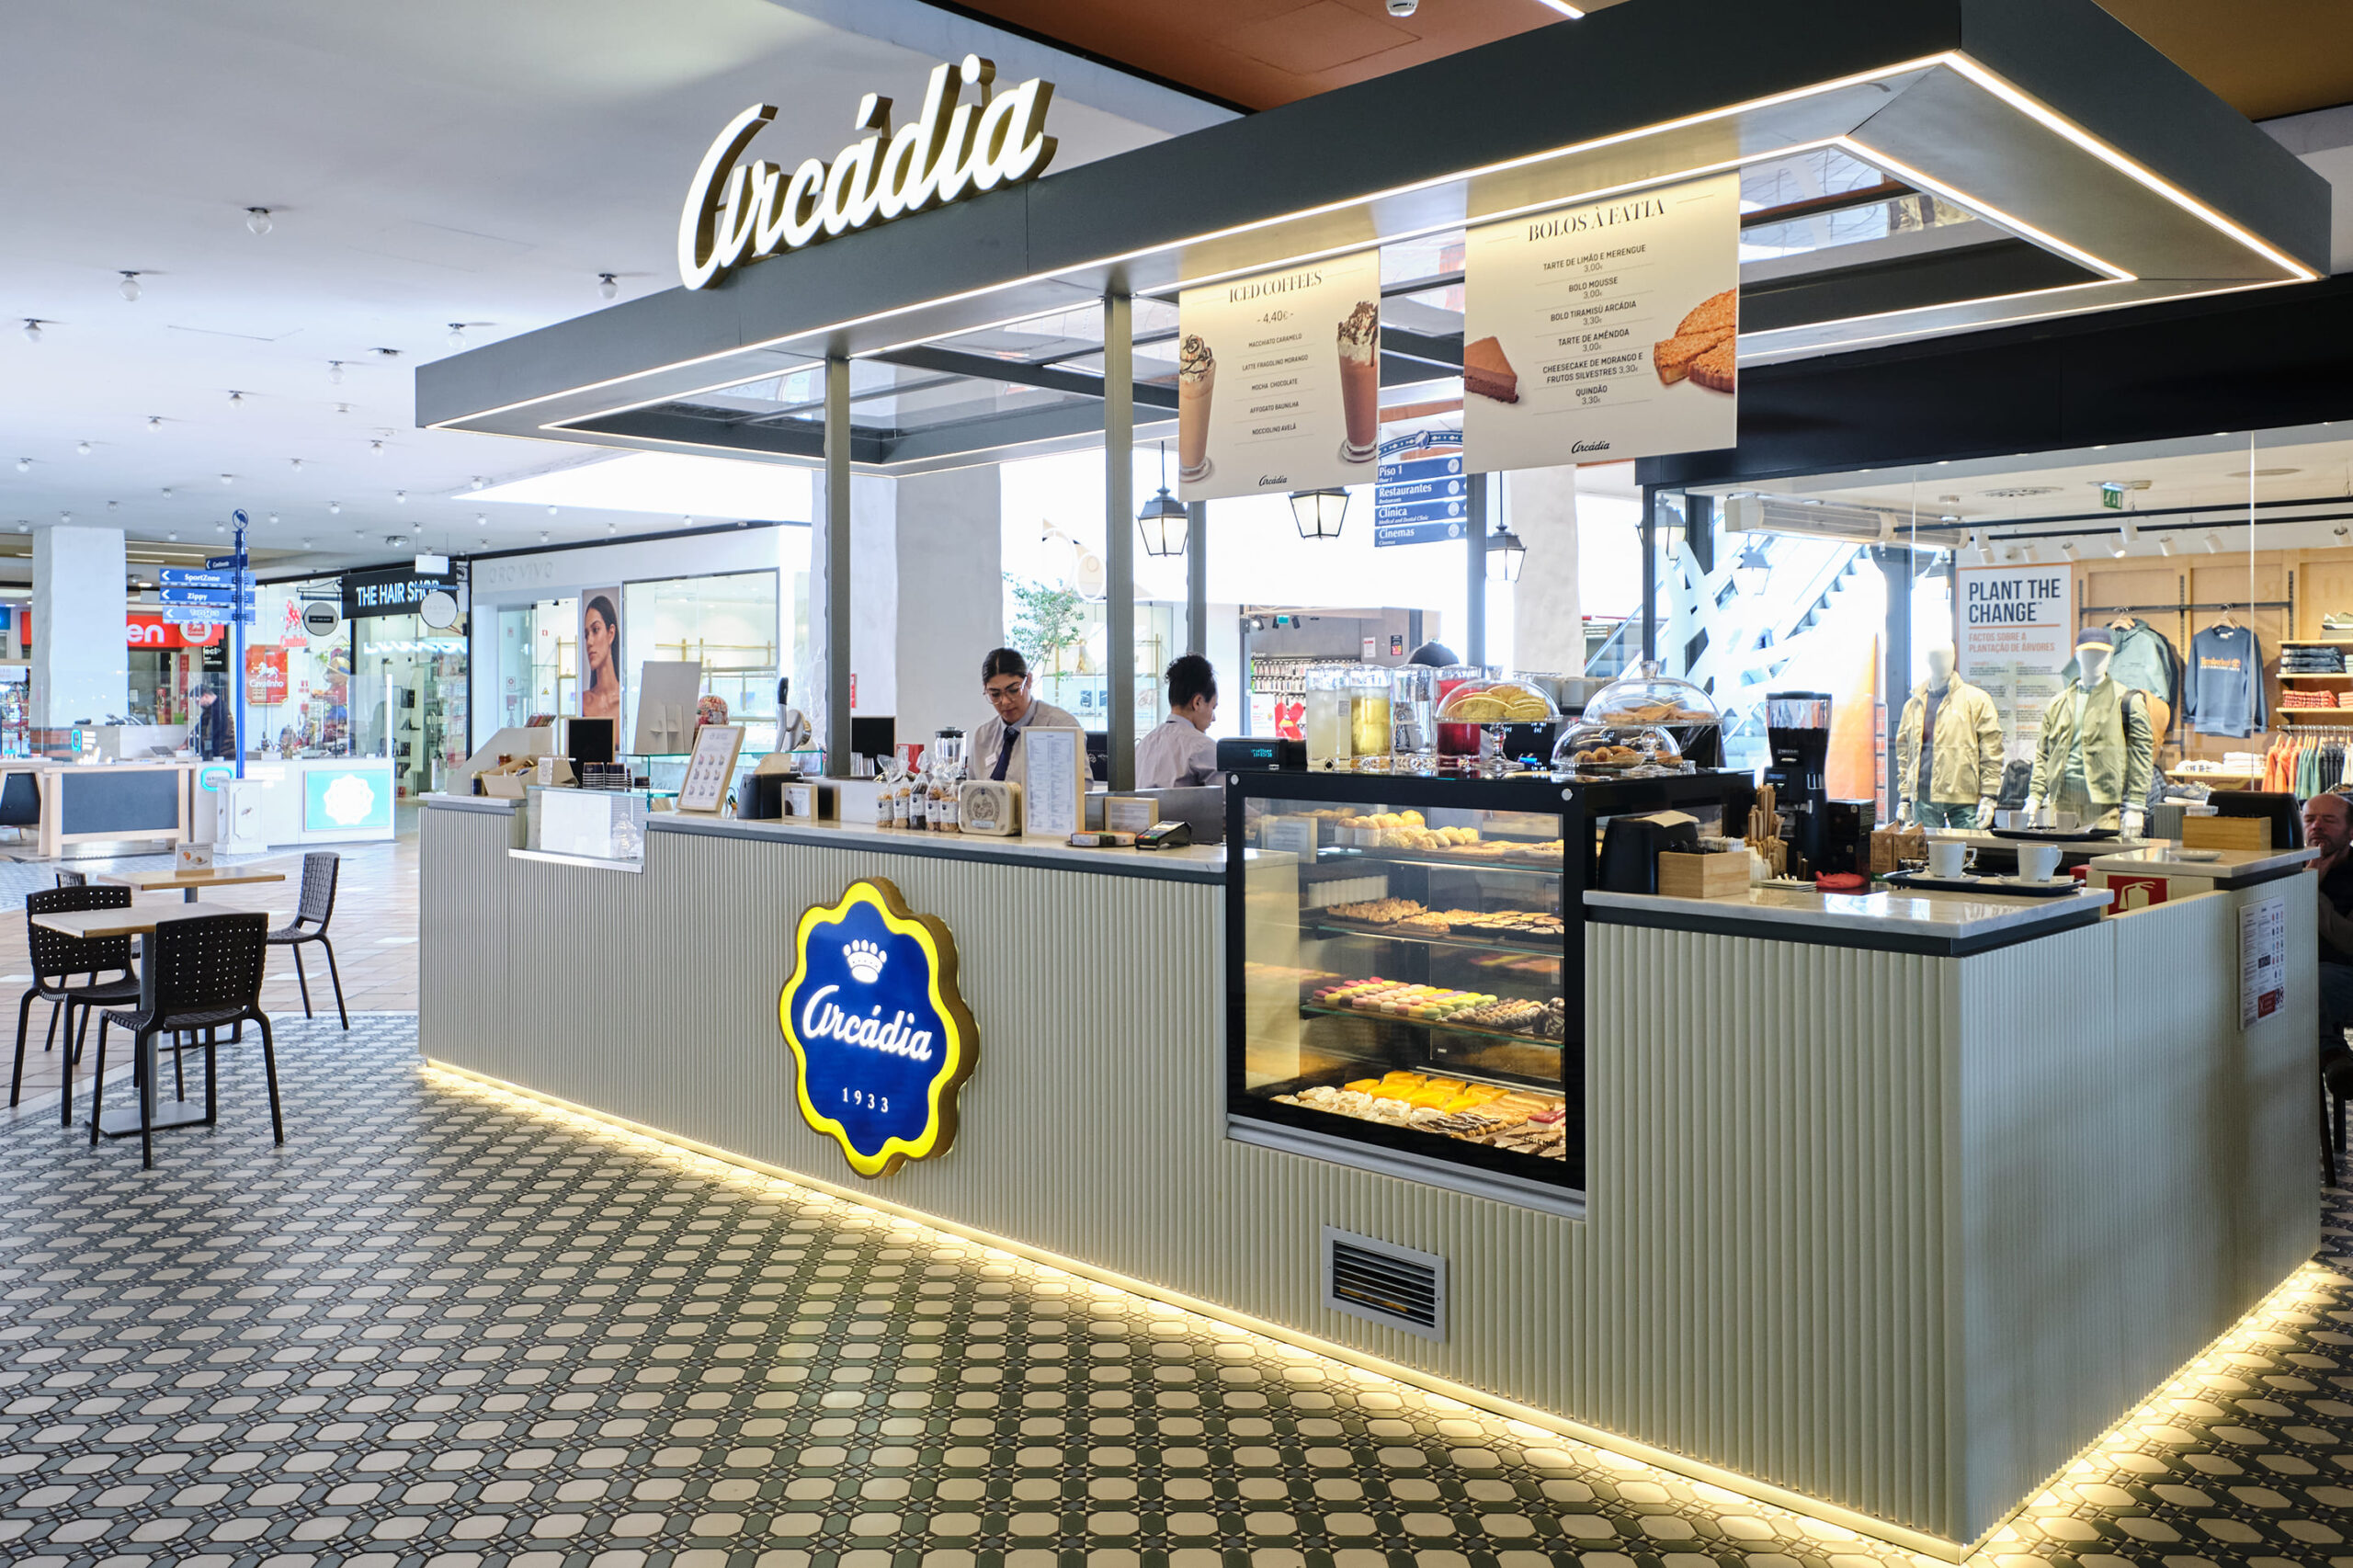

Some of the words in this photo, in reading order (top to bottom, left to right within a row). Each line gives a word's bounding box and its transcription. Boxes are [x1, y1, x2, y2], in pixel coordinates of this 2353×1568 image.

[677, 53, 1048, 290] Arcádia
[1529, 213, 1586, 242] BOLOS
[1608, 199, 1664, 225] FATIA
[1543, 259, 1564, 270] TARTE
[1566, 257, 1575, 267] DE
[1577, 252, 1598, 265] LIMÃO
[1600, 252, 1605, 260] E
[1606, 244, 1646, 259] MERENGUE
[1230, 284, 1260, 303] ICED
[1263, 269, 1322, 296] COFFEES
[1568, 282, 1587, 292] BOLO
[1589, 276, 1618, 288] MOUSSE
[1551, 312, 1569, 322] BOLO
[1605, 301, 1636, 312] ARCÁDIA
[1248, 338, 1276, 347] MACCHIATO
[1276, 333, 1302, 343] CARAMELO
[1558, 335, 1580, 347] TARTE
[1582, 334, 1591, 343] DE
[1242, 363, 1256, 371] LATTE
[1256, 358, 1283, 368] FRAGOLINO
[1284, 354, 1309, 363] MORANGO
[1542, 360, 1588, 374] CHEESECAKE
[1589, 358, 1599, 368] DE
[1601, 353, 1637, 366] MORANGO
[1638, 352, 1643, 360] E
[1547, 373, 1574, 383] FRUTOS
[1575, 367, 1618, 380] SILVESTRES
[1270, 378, 1298, 388] CHOCOLATE
[1575, 384, 1608, 397] QUINDÃO
[1250, 404, 1274, 414] AFFOGATO
[1275, 401, 1299, 410] BAUNILHA
[1252, 426, 1280, 435] NOCCIOLINO
[1571, 439, 1610, 454] Arcádia
[1379, 466, 1396, 476] Piso
[1398, 464, 1403, 475] 1
[1258, 474, 1288, 486] Arcádia
[1379, 483, 1432, 497] Restaurantes
[1379, 506, 1407, 518] Clínica
[1379, 528, 1415, 539] Cinemas
[184, 574, 221, 582] SportZone
[356, 585, 378, 607] THE
[379, 582, 405, 605] HAIR
[1969, 580, 2023, 601] PLANT
[2027, 578, 2061, 598] THE
[187, 593, 208, 601] Zippy
[1969, 632, 1995, 642] FACTOS
[2021, 631, 2027, 640] A
[1969, 642, 2009, 653] PLANTAÇÃO
[2010, 643, 2019, 652] DE
[802, 983, 933, 1062] Arcádia
[842, 1086, 889, 1113] 1933
